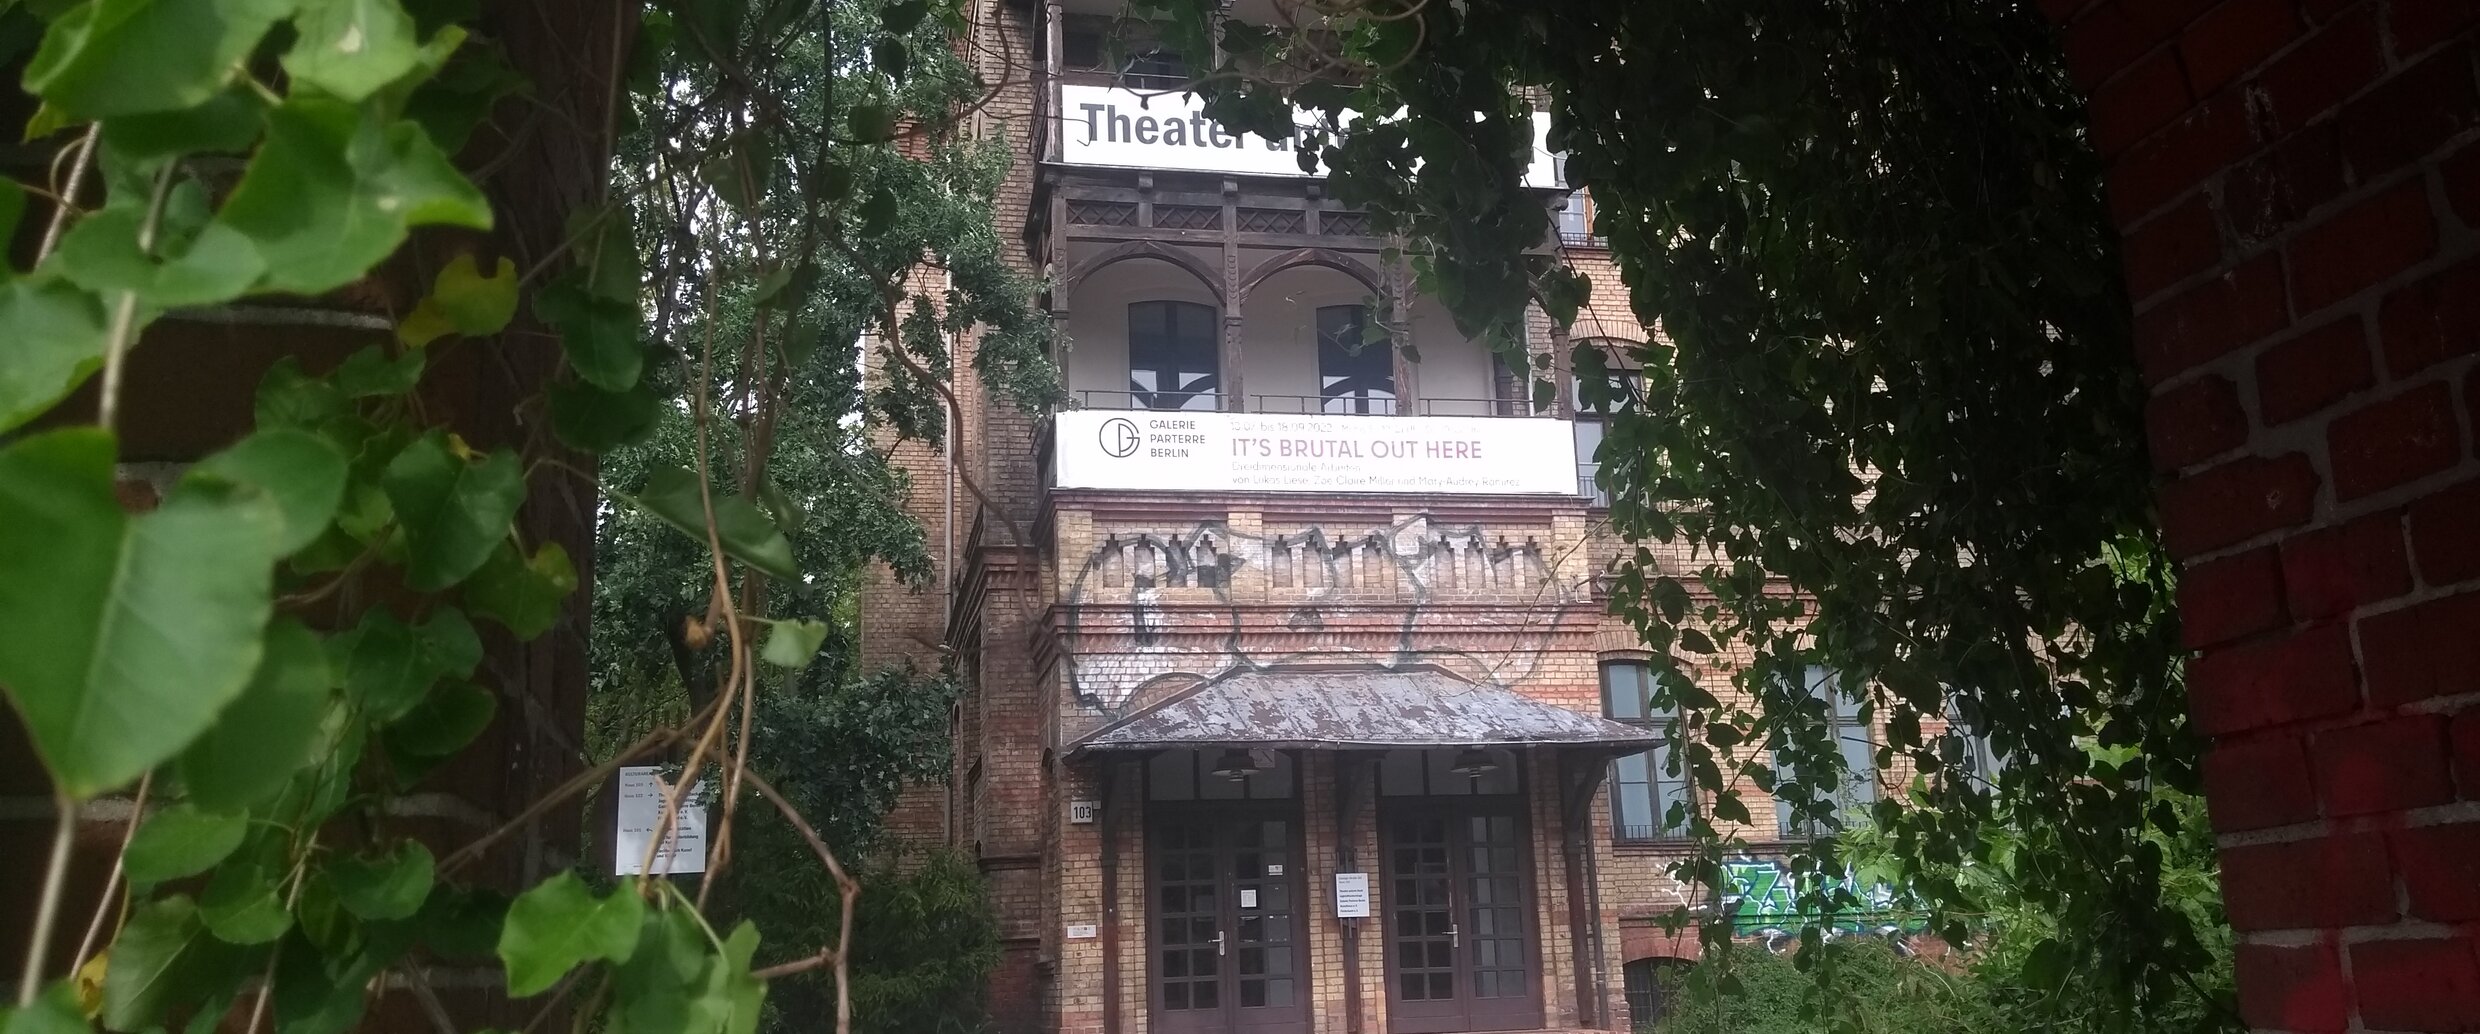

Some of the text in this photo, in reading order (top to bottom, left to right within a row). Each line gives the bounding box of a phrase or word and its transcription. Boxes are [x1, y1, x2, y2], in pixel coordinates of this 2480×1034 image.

[1149, 419, 1196, 430] GALERIE
[1260, 421, 1275, 432] bis
[1150, 434, 1206, 444] PARTERRE
[1150, 448, 1189, 458] BERLIN
[1232, 438, 1482, 459] IT'S BRUTAL OUT HERE
[1232, 476, 1250, 484] von
[1335, 475, 1366, 486] Claire
[1073, 806, 1092, 819] 103
